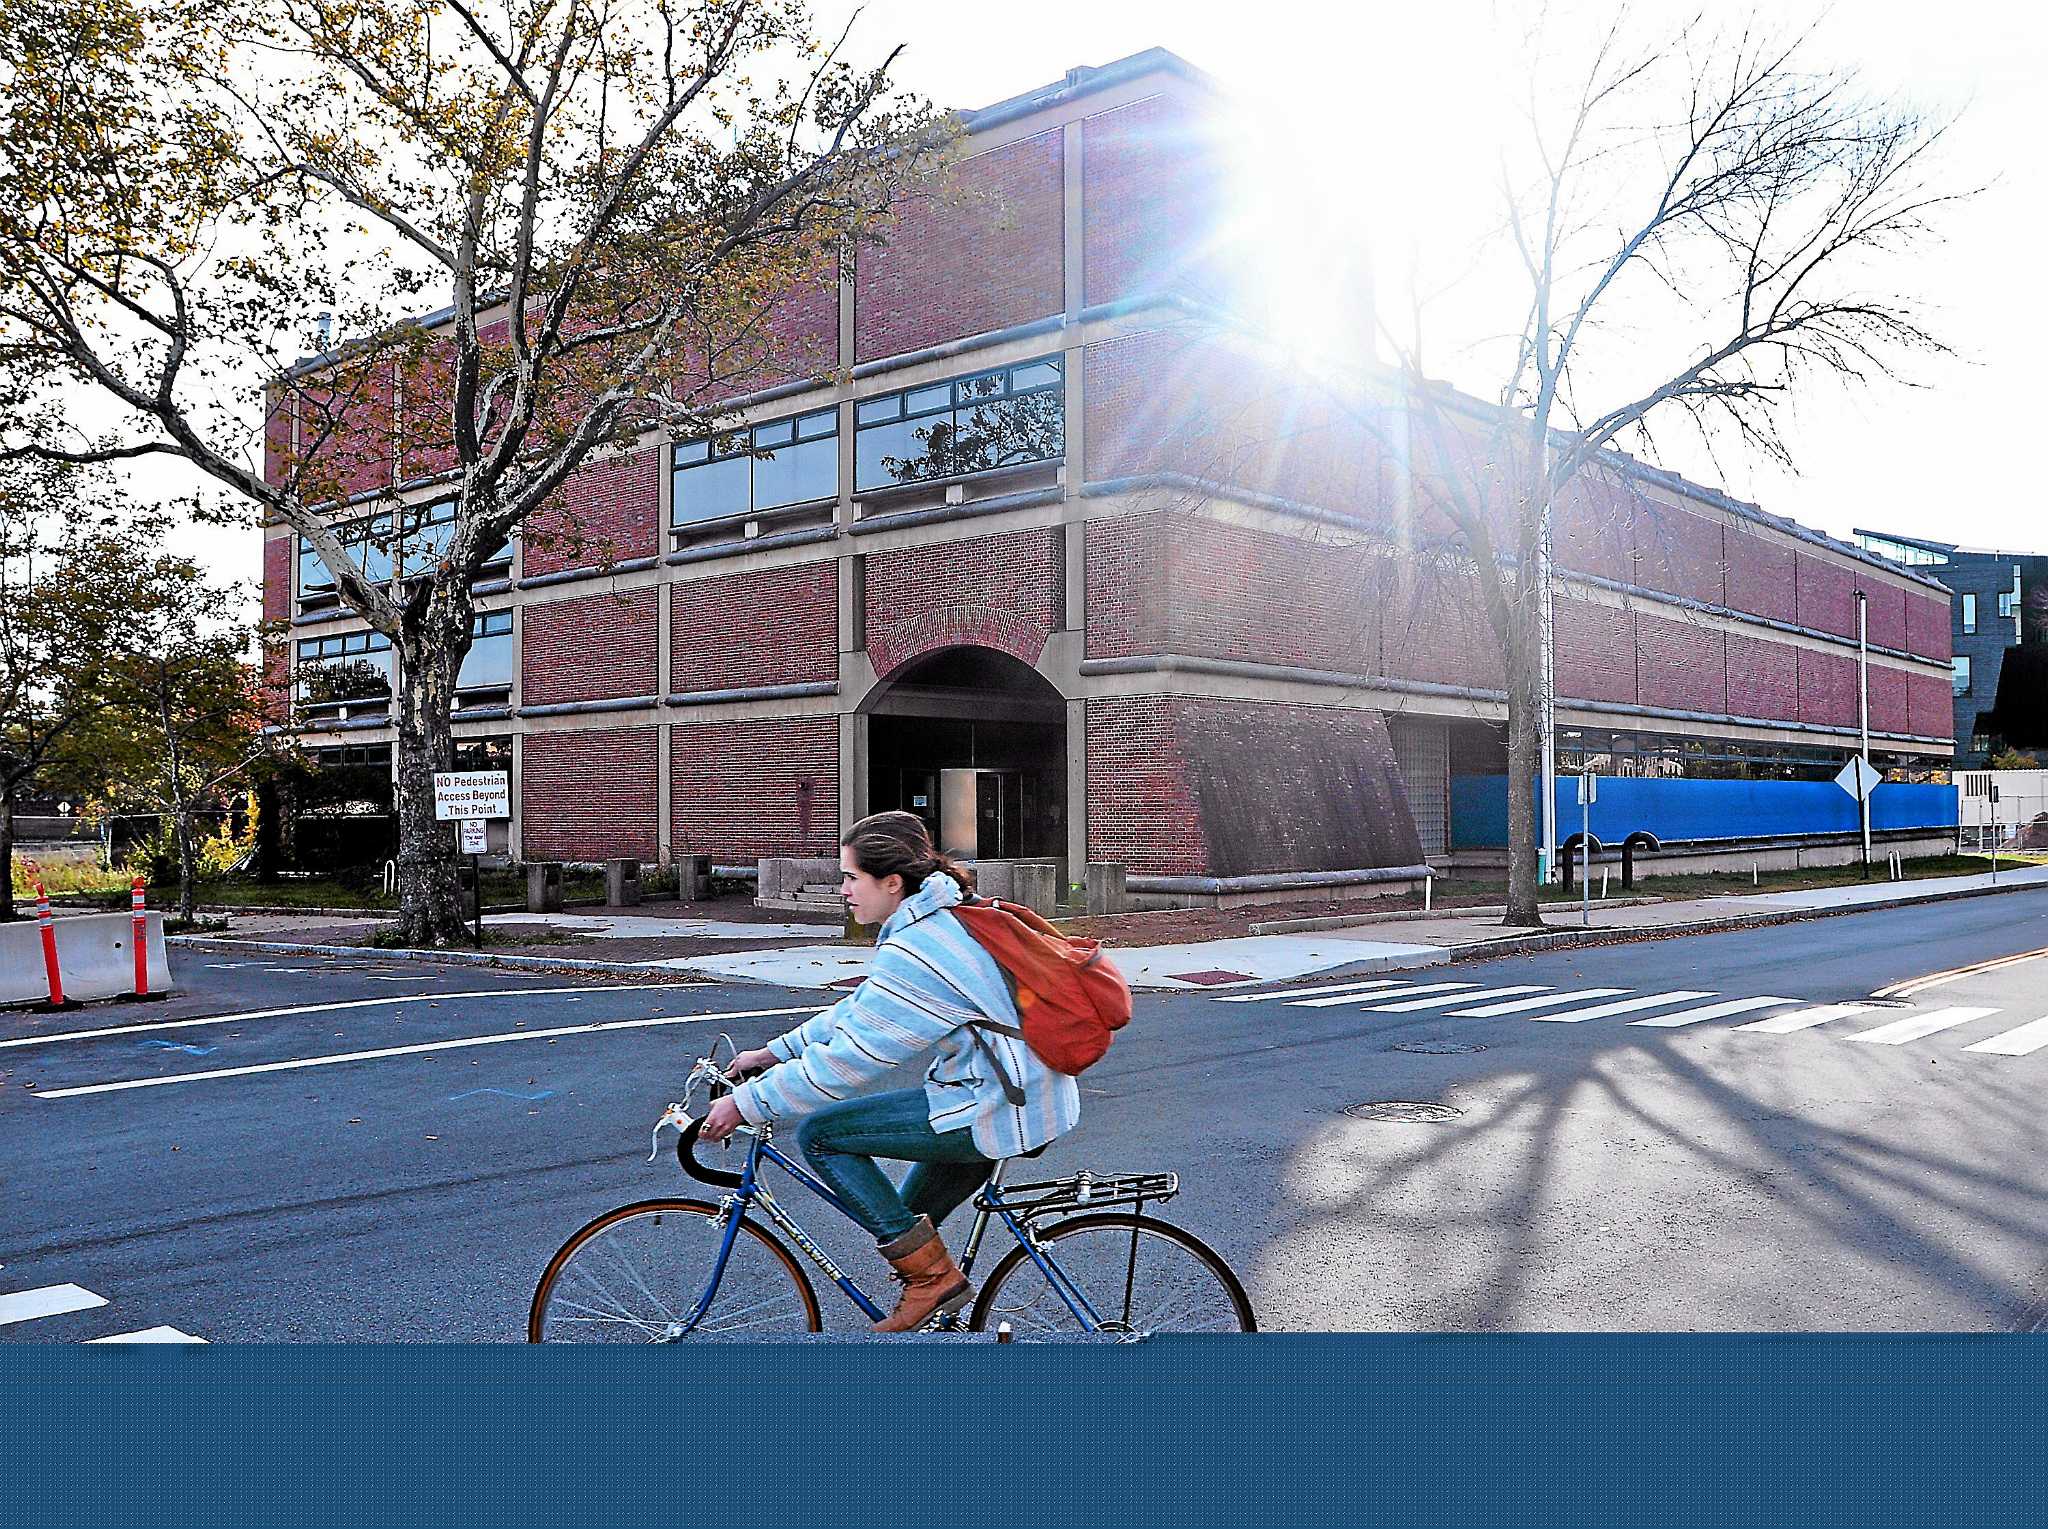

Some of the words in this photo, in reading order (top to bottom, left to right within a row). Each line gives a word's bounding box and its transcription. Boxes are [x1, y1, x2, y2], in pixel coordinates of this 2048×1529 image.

[436, 777, 451, 787] NO
[454, 775, 506, 787] Pedestrian
[437, 791, 471, 802] Access
[472, 789, 506, 801] Beyond
[448, 805, 469, 815] This
[471, 804, 497, 814] Point
